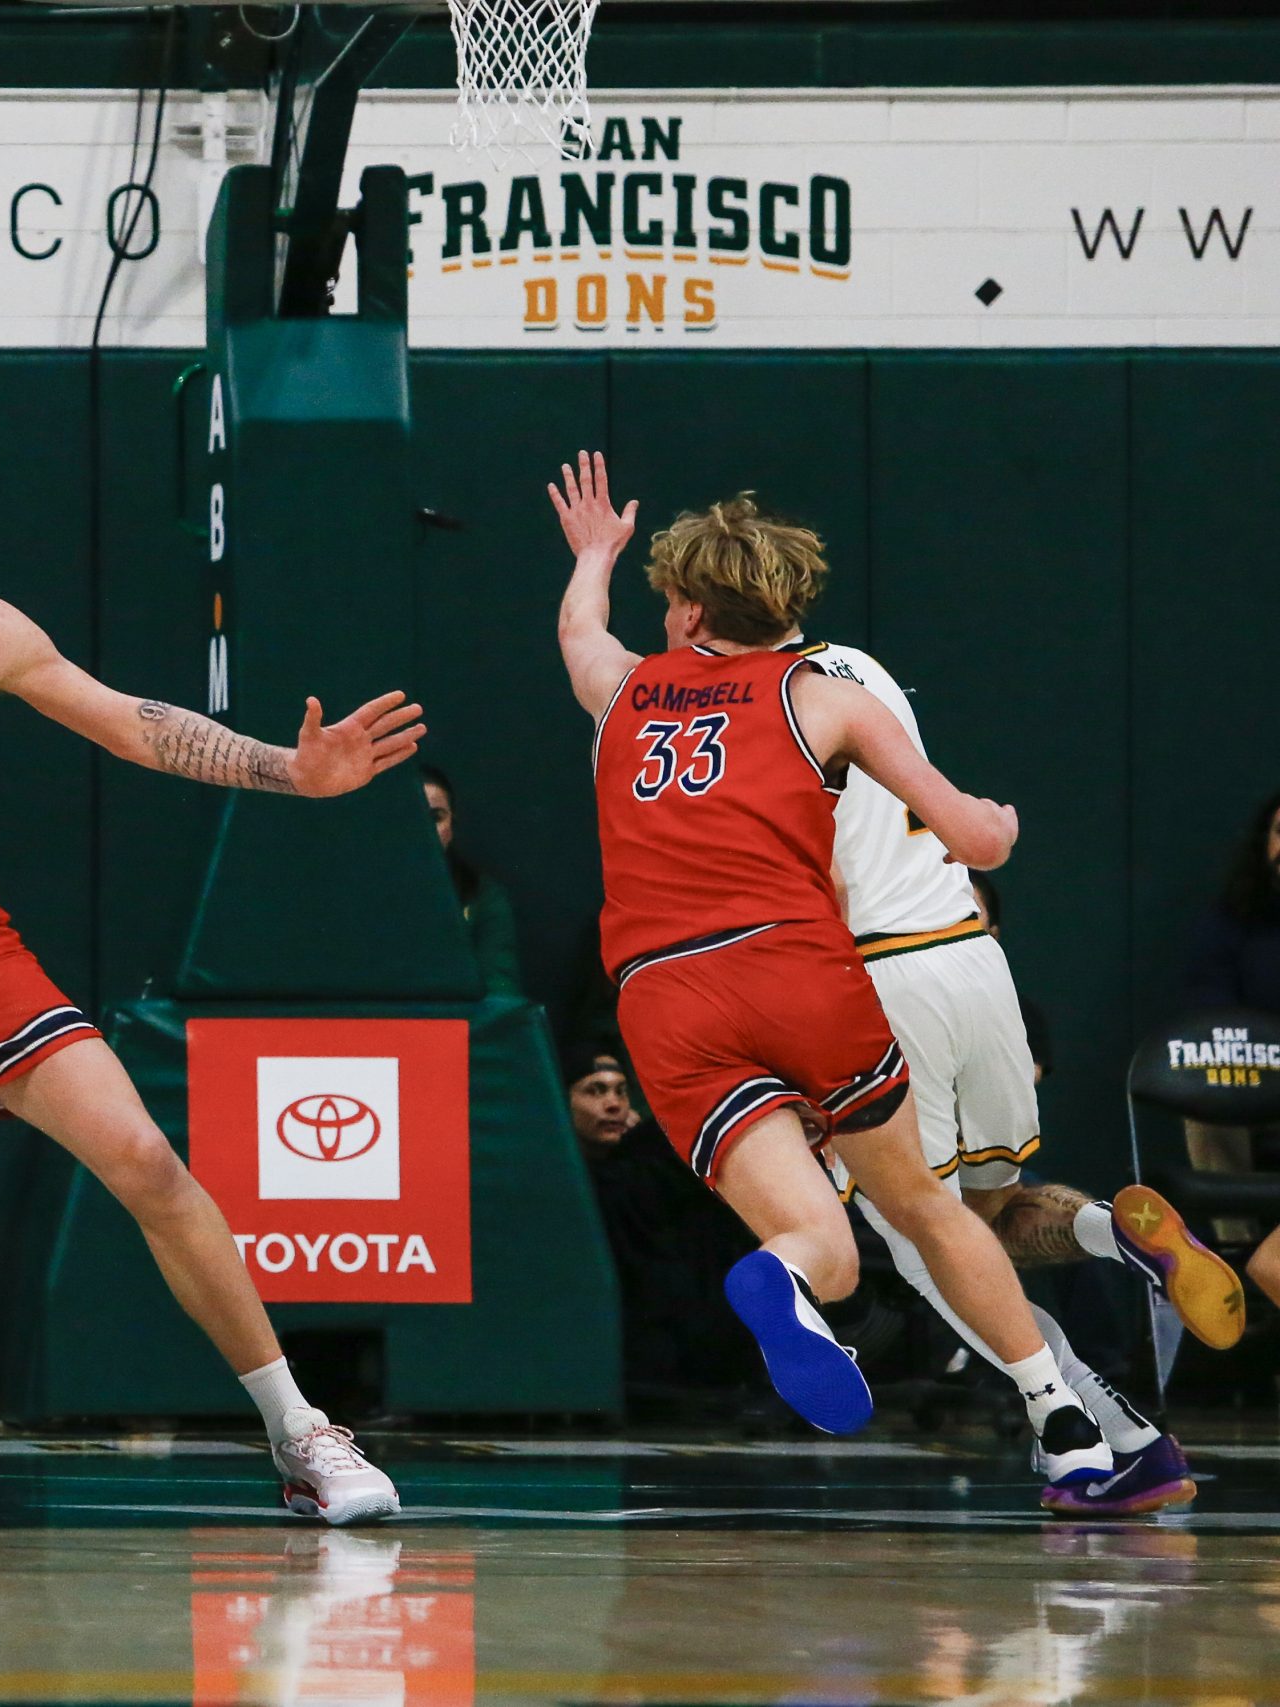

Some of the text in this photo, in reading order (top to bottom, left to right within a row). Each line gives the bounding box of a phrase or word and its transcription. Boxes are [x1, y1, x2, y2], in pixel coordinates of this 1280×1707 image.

[560, 117, 682, 161] SAN
[523, 273, 716, 324] DONS
[632, 682, 754, 713] CAMPBELL
[632, 711, 730, 802] 33
[1211, 1026, 1249, 1042] SAN
[233, 1232, 438, 1274] TOYOTA
